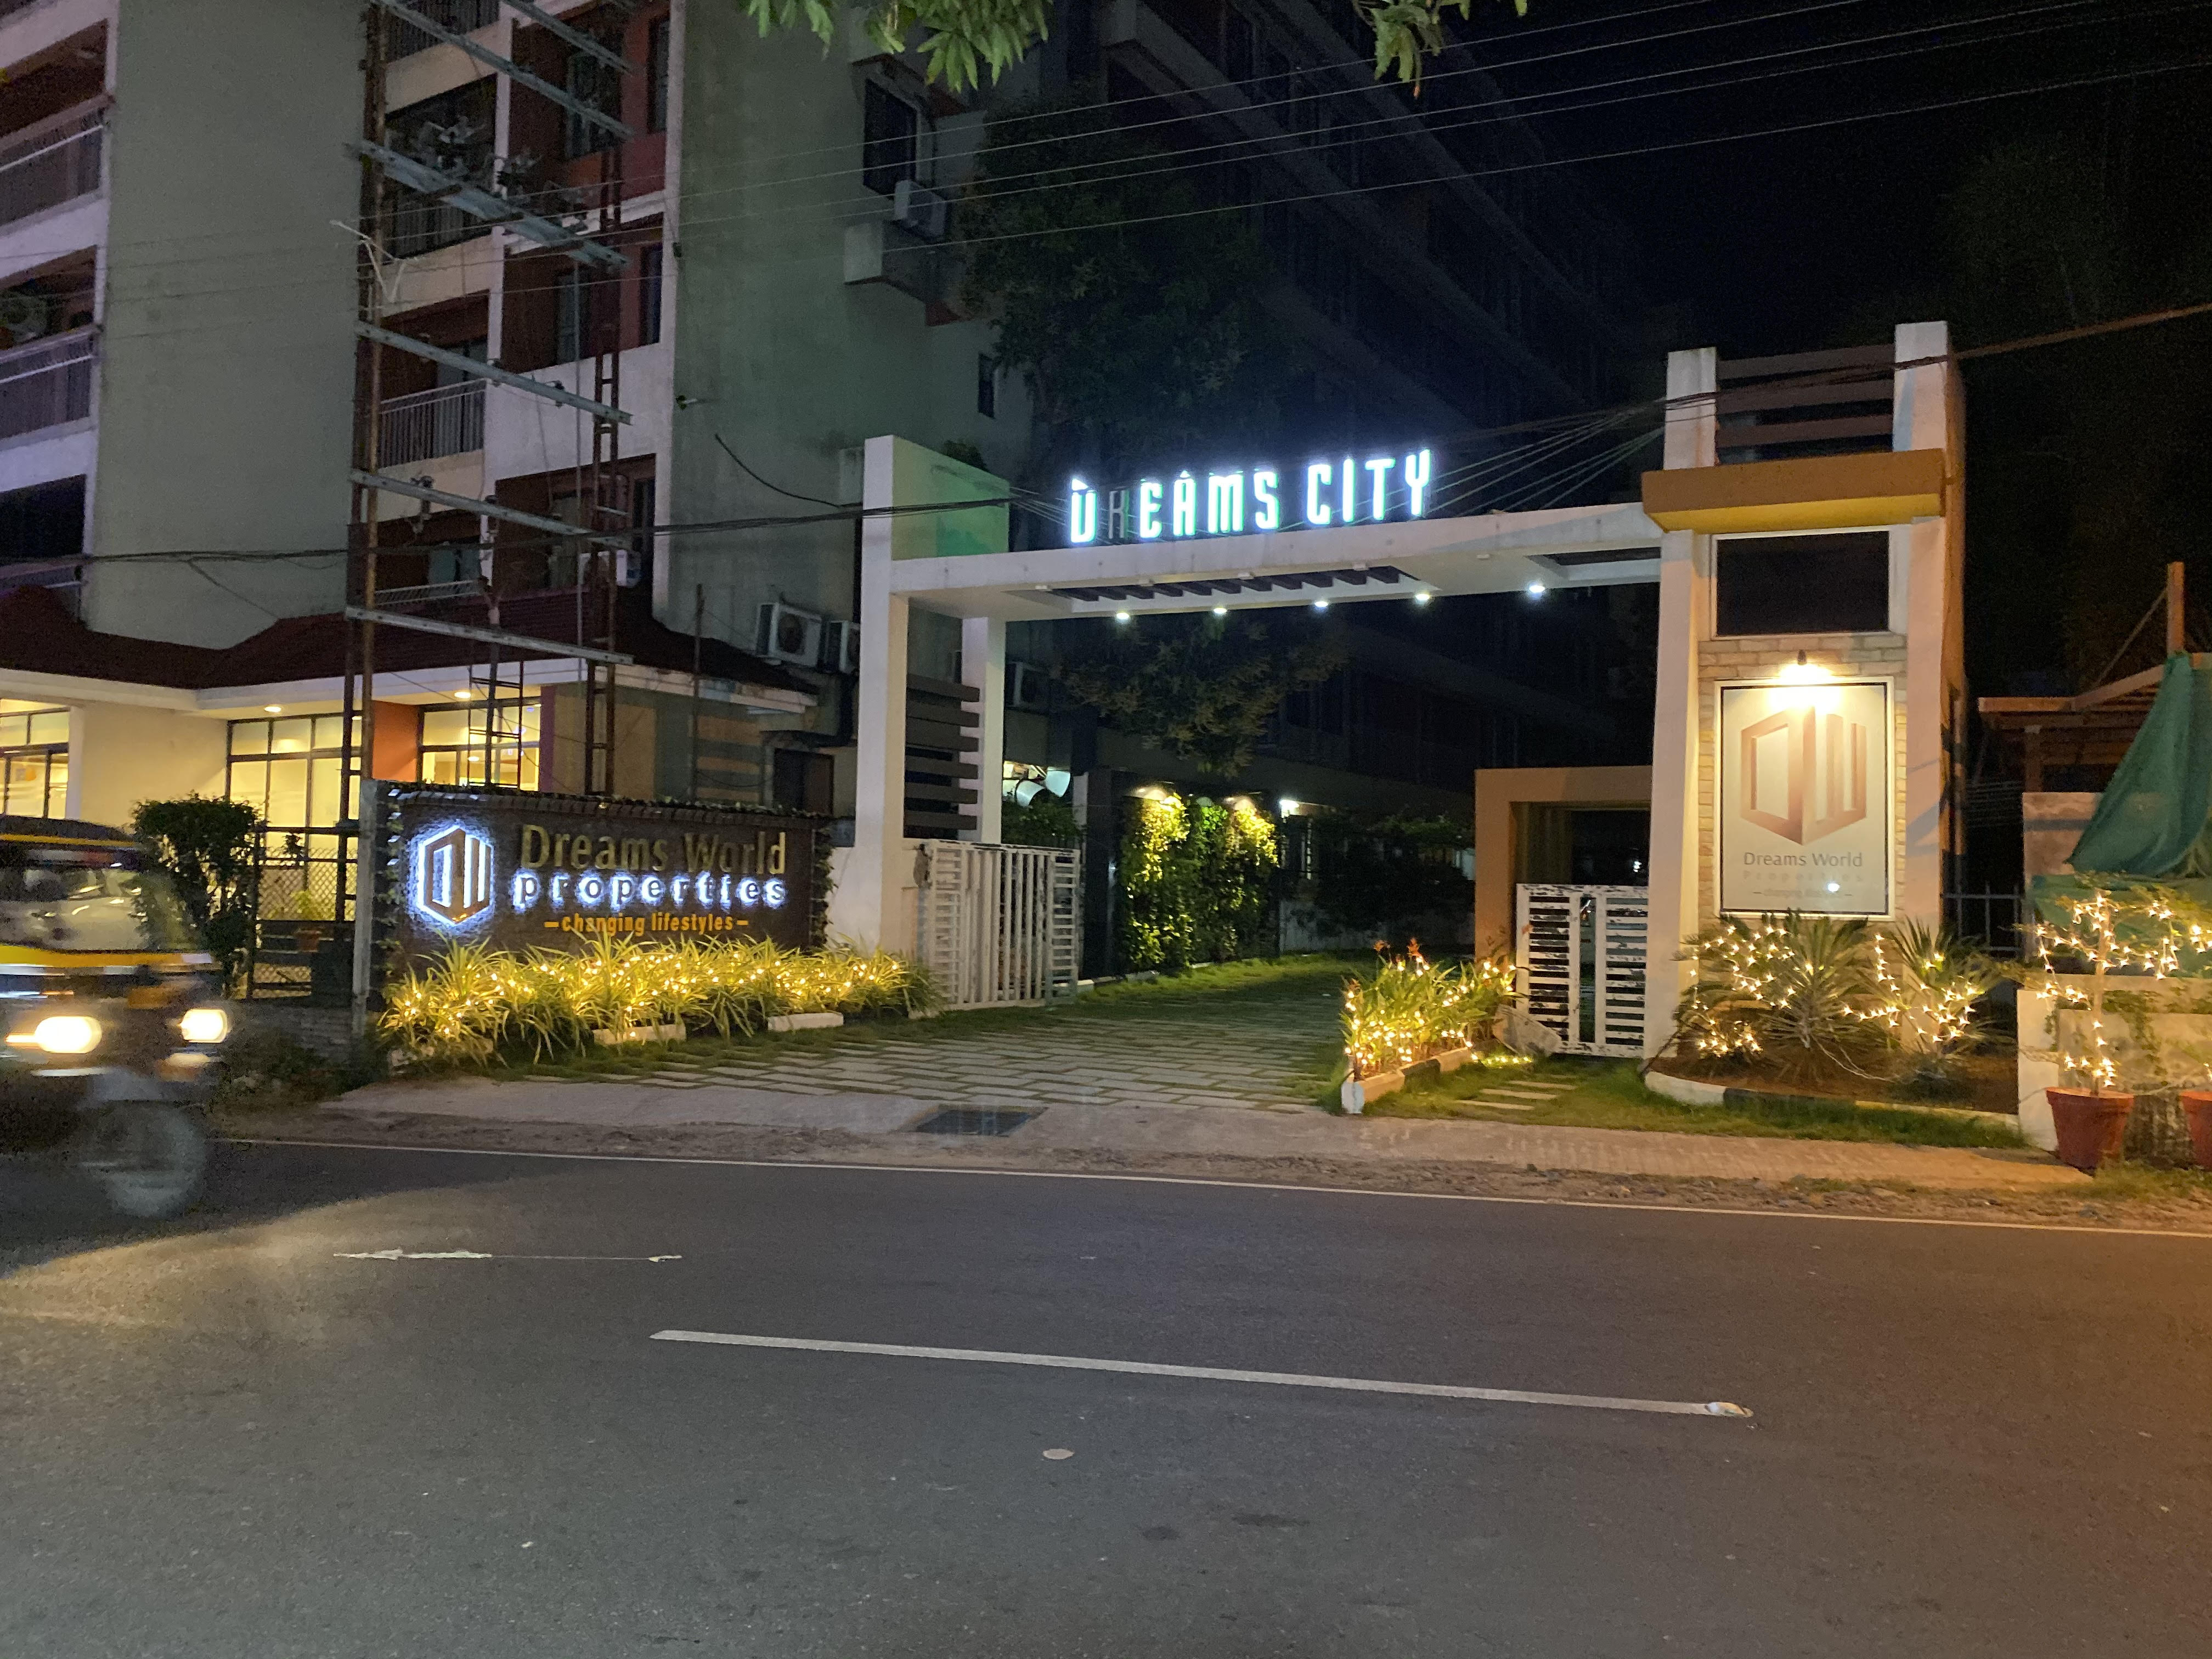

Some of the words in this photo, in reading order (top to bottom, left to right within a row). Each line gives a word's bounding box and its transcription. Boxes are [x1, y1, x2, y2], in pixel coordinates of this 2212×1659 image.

[1071, 469, 1280, 543] DREAMS
[1307, 449, 1431, 524] CITY
[521, 824, 668, 872] Dreams
[684, 831, 786, 874] World
[1743, 851, 1807, 866] Dreams
[1812, 851, 1863, 867] World
[515, 871, 787, 909] properties
[562, 912, 645, 936] changing
[651, 911, 733, 935] lifestyles
